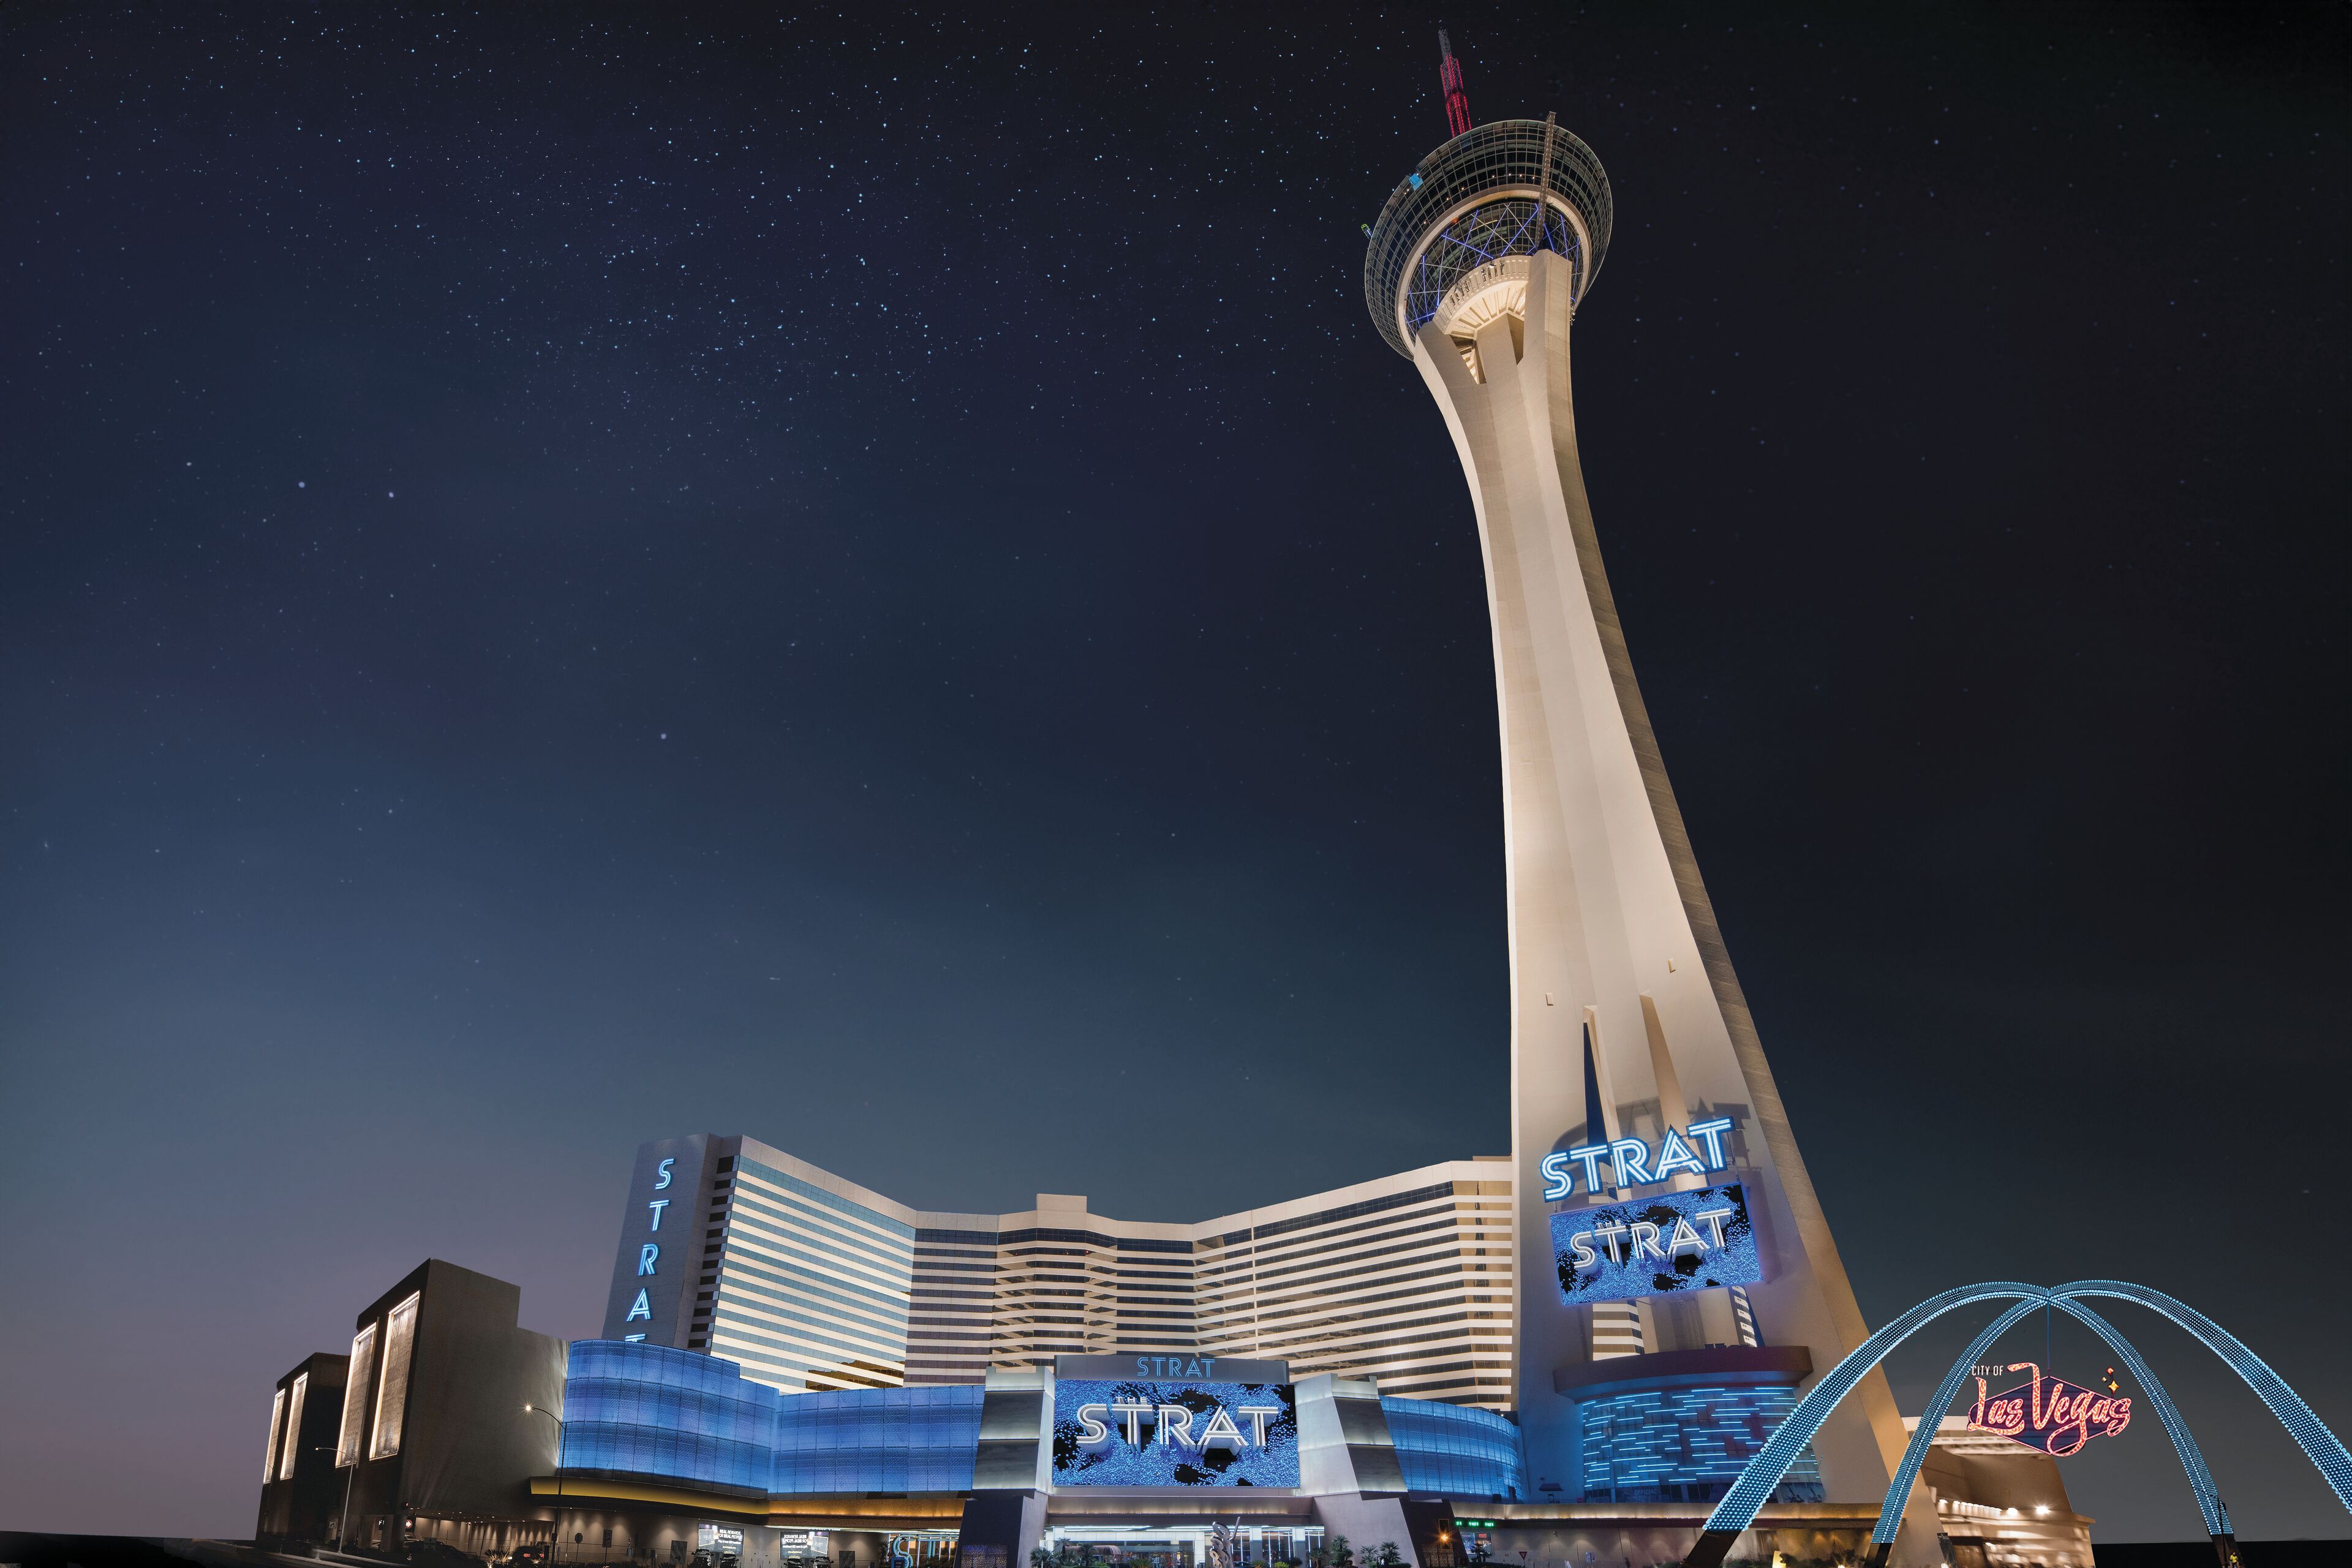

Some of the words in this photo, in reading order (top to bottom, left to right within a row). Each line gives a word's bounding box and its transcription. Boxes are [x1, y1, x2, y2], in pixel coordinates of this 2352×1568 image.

[1541, 1118, 1734, 1201] STRAT
[625, 1158, 674, 1342] STRA
[1570, 1208, 1731, 1269] STRAT
[1596, 1220, 1621, 1229] THE
[1137, 1357, 1216, 1378] STRAT
[1971, 1365, 1990, 1376] CITY
[1993, 1365, 2003, 1376] OF
[1076, 1403, 1279, 1448] STRAT
[1967, 1377, 2024, 1436] Las
[2007, 1362, 2132, 1457] Vegas
